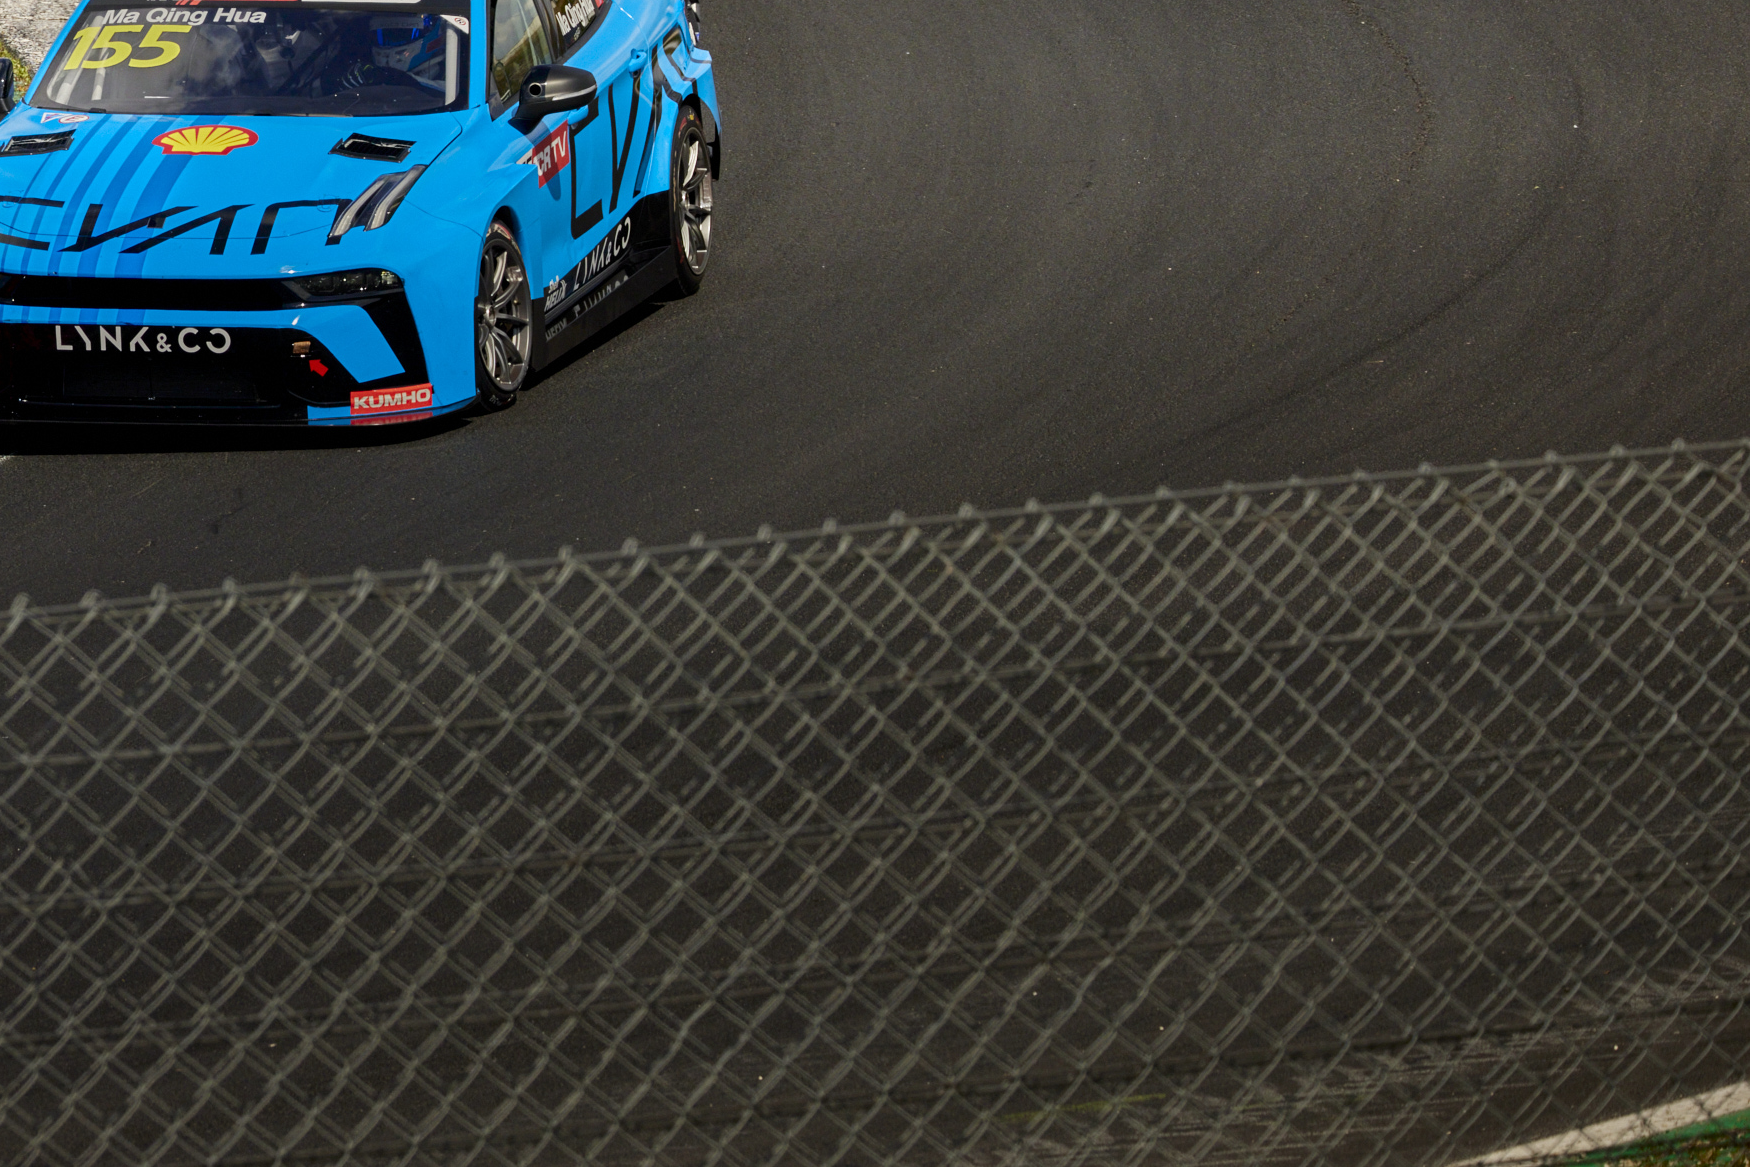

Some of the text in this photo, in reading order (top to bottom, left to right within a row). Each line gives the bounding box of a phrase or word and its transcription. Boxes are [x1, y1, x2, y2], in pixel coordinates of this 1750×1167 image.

[102, 7, 266, 26] Ma Qing Hua
[63, 23, 192, 71] 155
[551, 130, 567, 163] TV
[353, 386, 432, 410] KUMHO
